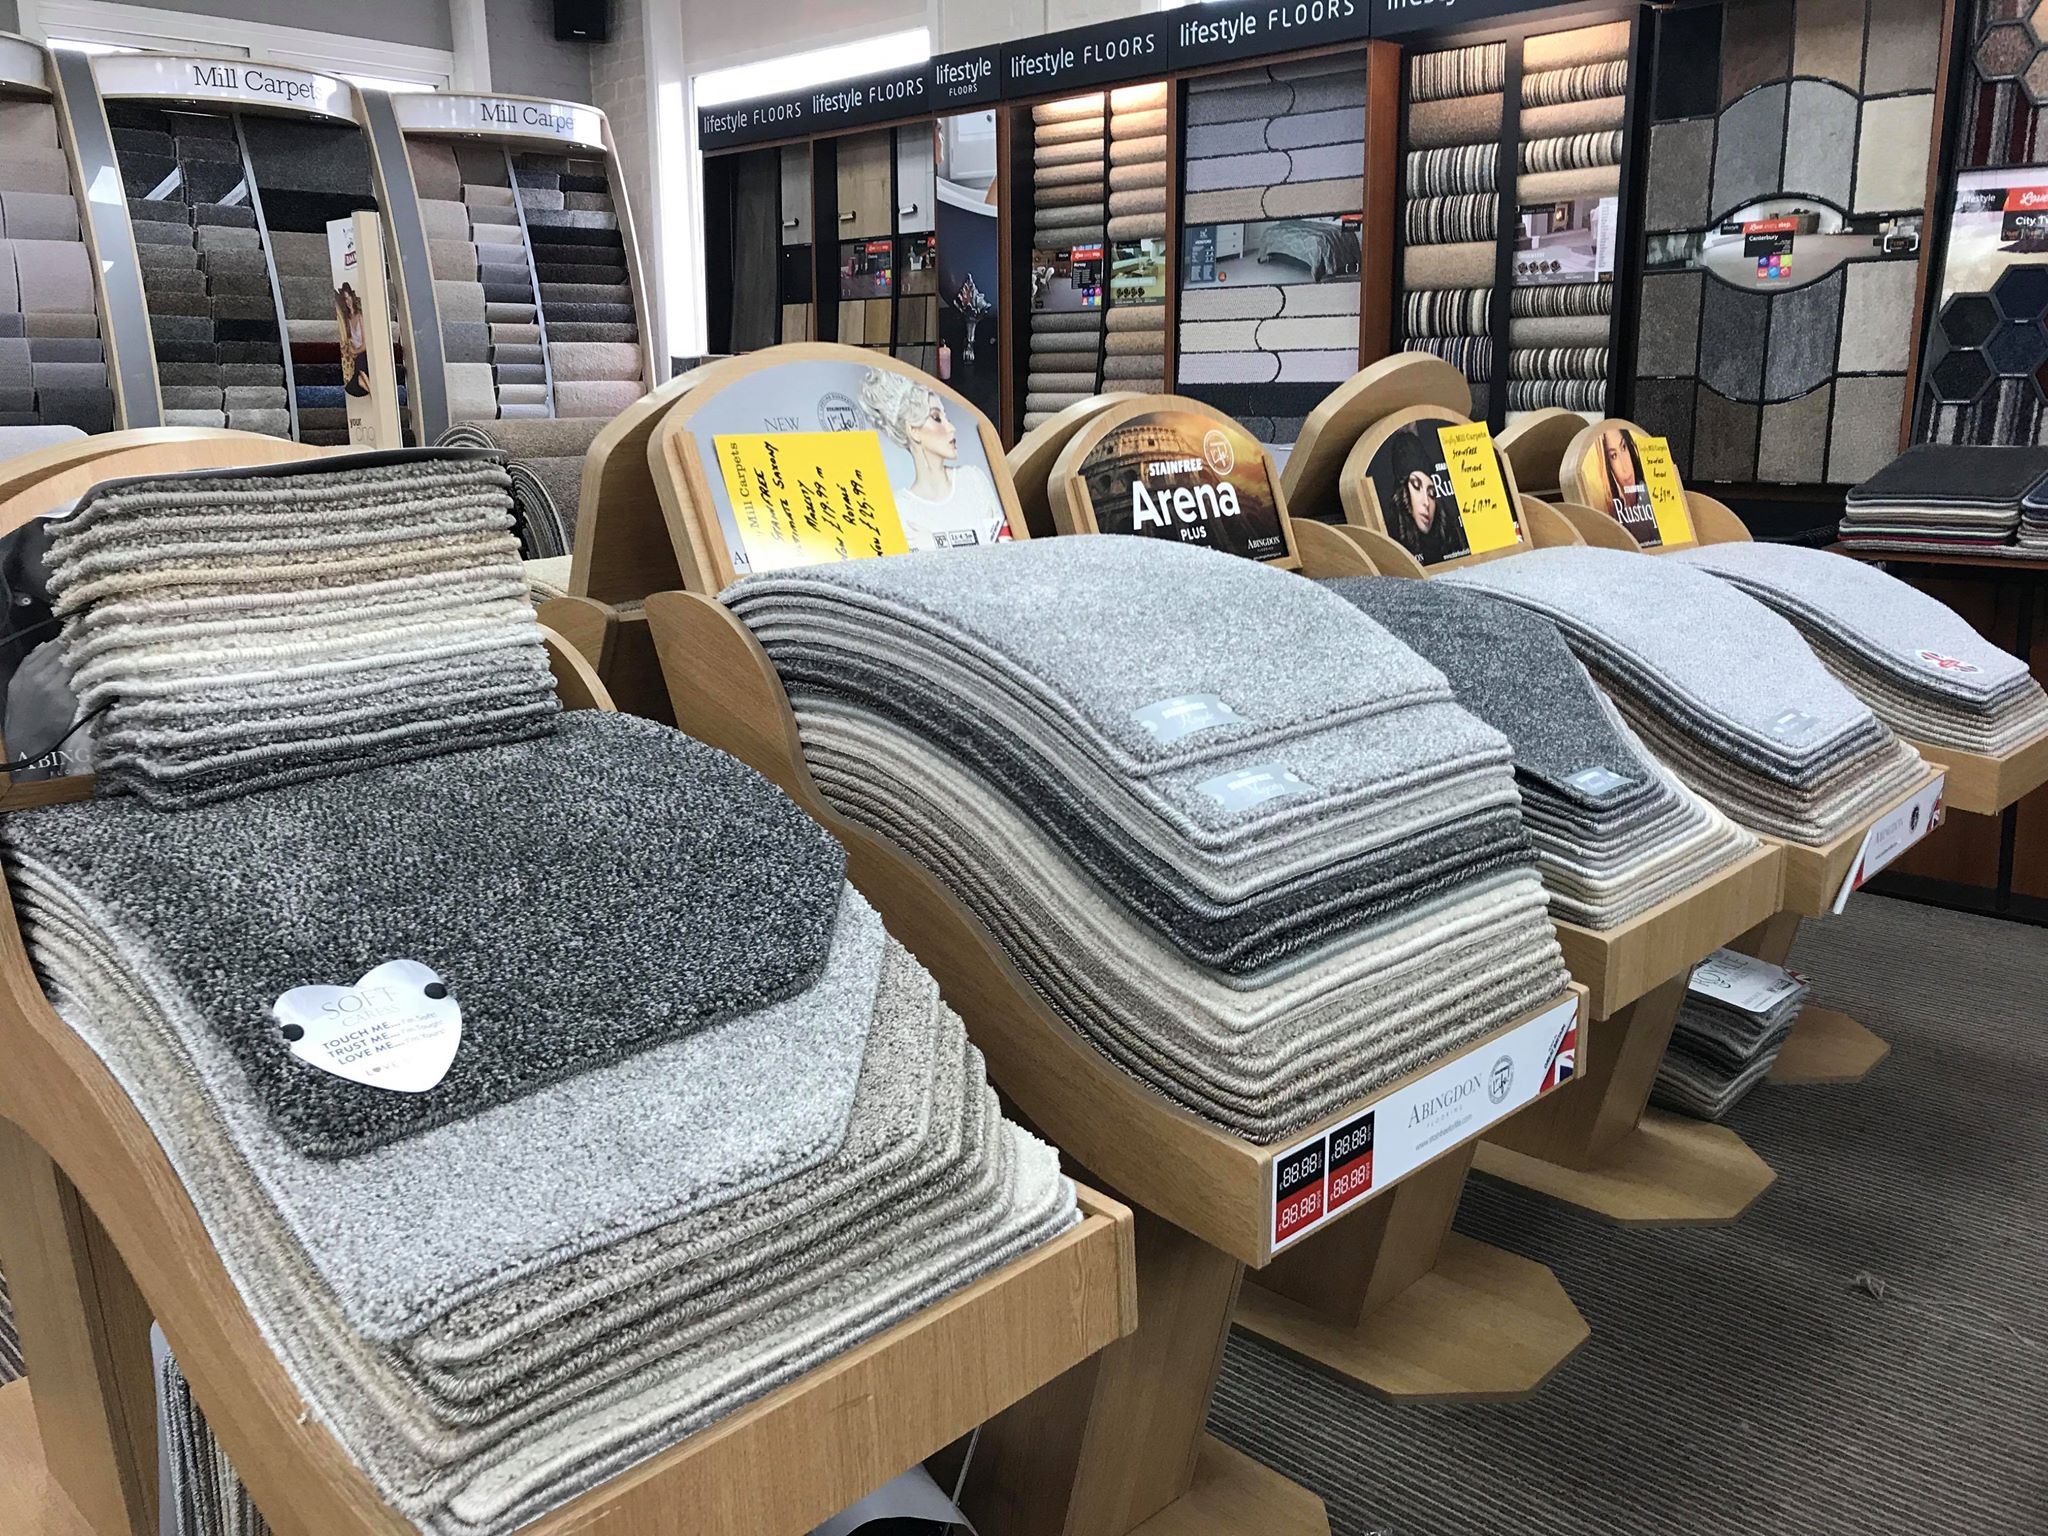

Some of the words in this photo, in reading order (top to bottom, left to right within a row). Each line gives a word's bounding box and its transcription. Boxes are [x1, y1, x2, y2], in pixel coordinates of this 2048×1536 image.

[1180, 12, 1256, 47] lifestyle
[1268, 0, 1354, 30] FLOORS
[1011, 48, 1074, 78] lifestyle
[1083, 34, 1155, 63] FLOORS
[193, 65, 239, 89] Mill
[936, 57, 991, 85] lifestyle
[812, 88, 862, 114] lifestyle
[869, 78, 924, 103] FLOORS
[949, 83, 988, 96] FLOORS
[481, 103, 518, 123] Mill
[523, 107, 574, 133] Carpe
[703, 110, 748, 134] lifestyle
[753, 102, 801, 125] FLOORS
[2015, 216, 2036, 226] City
[350, 417, 361, 428] your
[764, 416, 800, 432] NEW
[729, 442, 751, 497] Carpets
[1149, 458, 1203, 477] STAINFREE
[743, 500, 761, 529] Mill
[1132, 480, 1241, 530] Arena
[1613, 498, 1657, 528] Rustiq
[1180, 525, 1207, 541] PLUS
[1248, 536, 1281, 550] ABINGDON
[322, 986, 397, 1020] SOFT
[322, 1028, 369, 1050] TOUCH
[327, 1039, 368, 1058] TRUST
[338, 1049, 373, 1065] LOVE
[1408, 1073, 1483, 1128] ABINGDON
